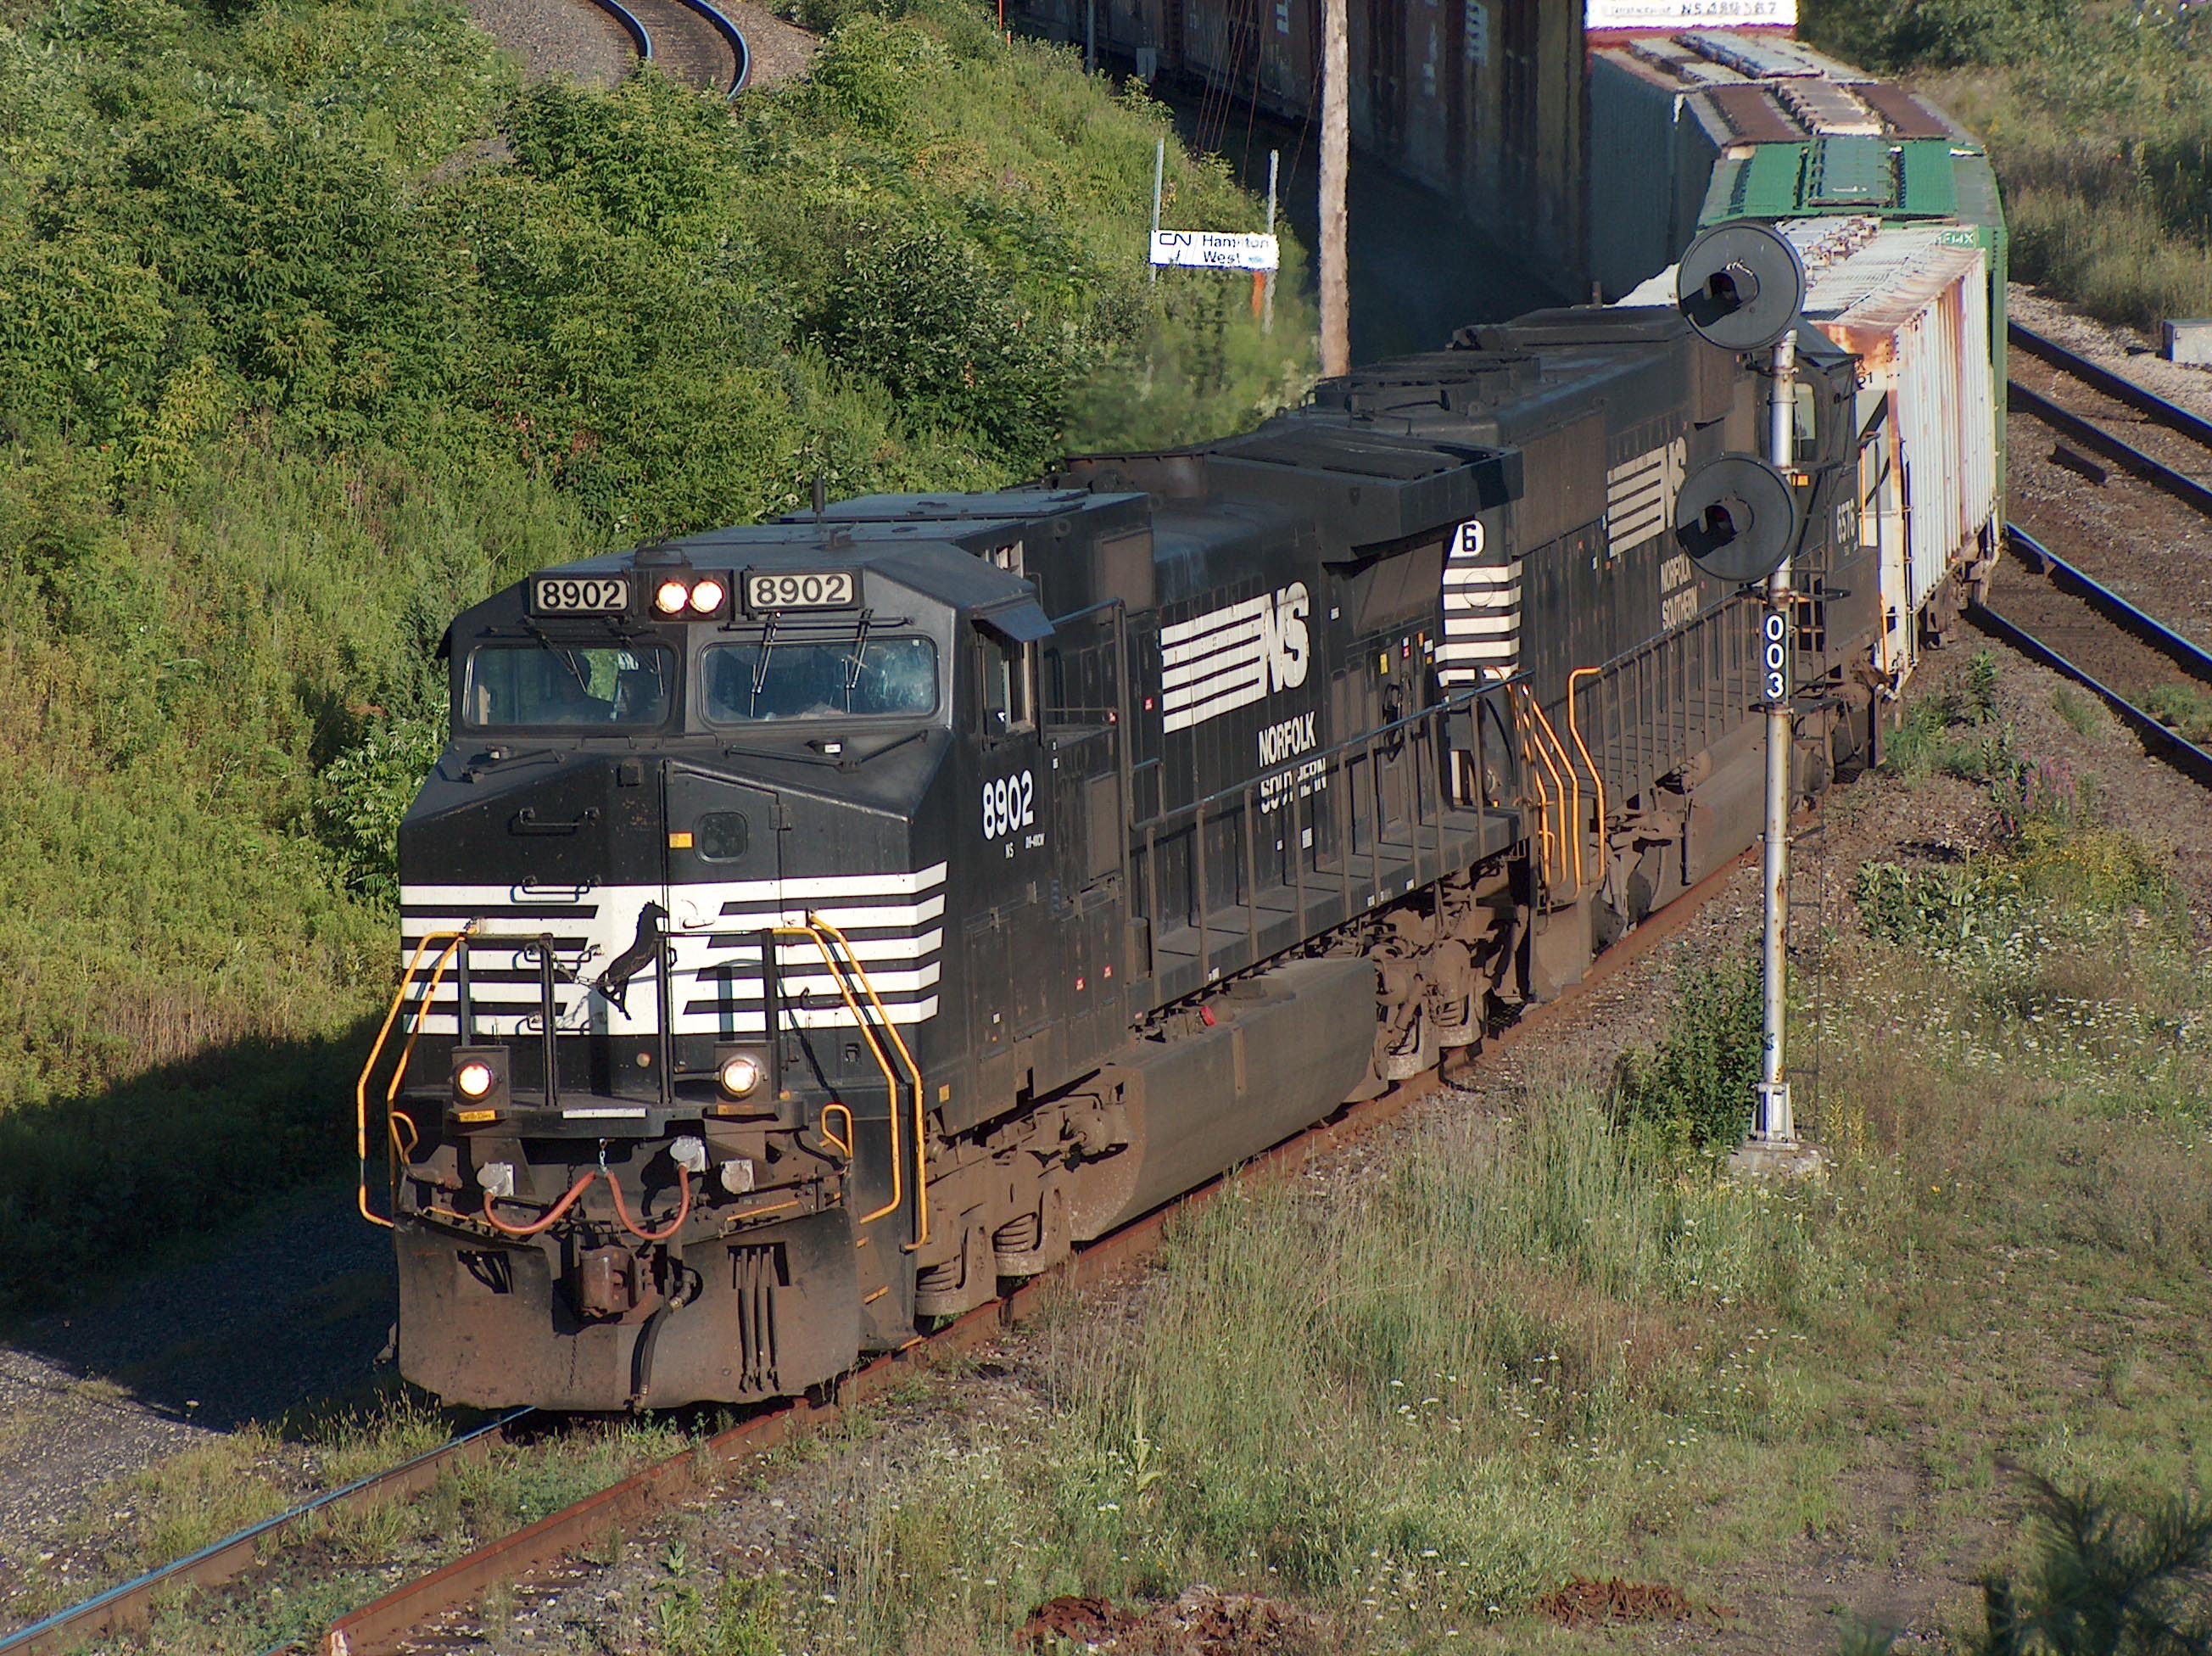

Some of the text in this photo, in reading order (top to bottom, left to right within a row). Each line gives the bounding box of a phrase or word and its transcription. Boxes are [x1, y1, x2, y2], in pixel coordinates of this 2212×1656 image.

[1159, 232, 1192, 246] CN
[1204, 250, 1241, 264] West
[756, 574, 846, 605] 8902
[1660, 552, 1692, 594] NORFOLK
[543, 581, 623, 609] 8902
[1661, 585, 1699, 630] SOUTHERN
[1263, 581, 1310, 694] NS
[1258, 710, 1316, 769] NORFOLK
[983, 769, 1034, 841] 8902
